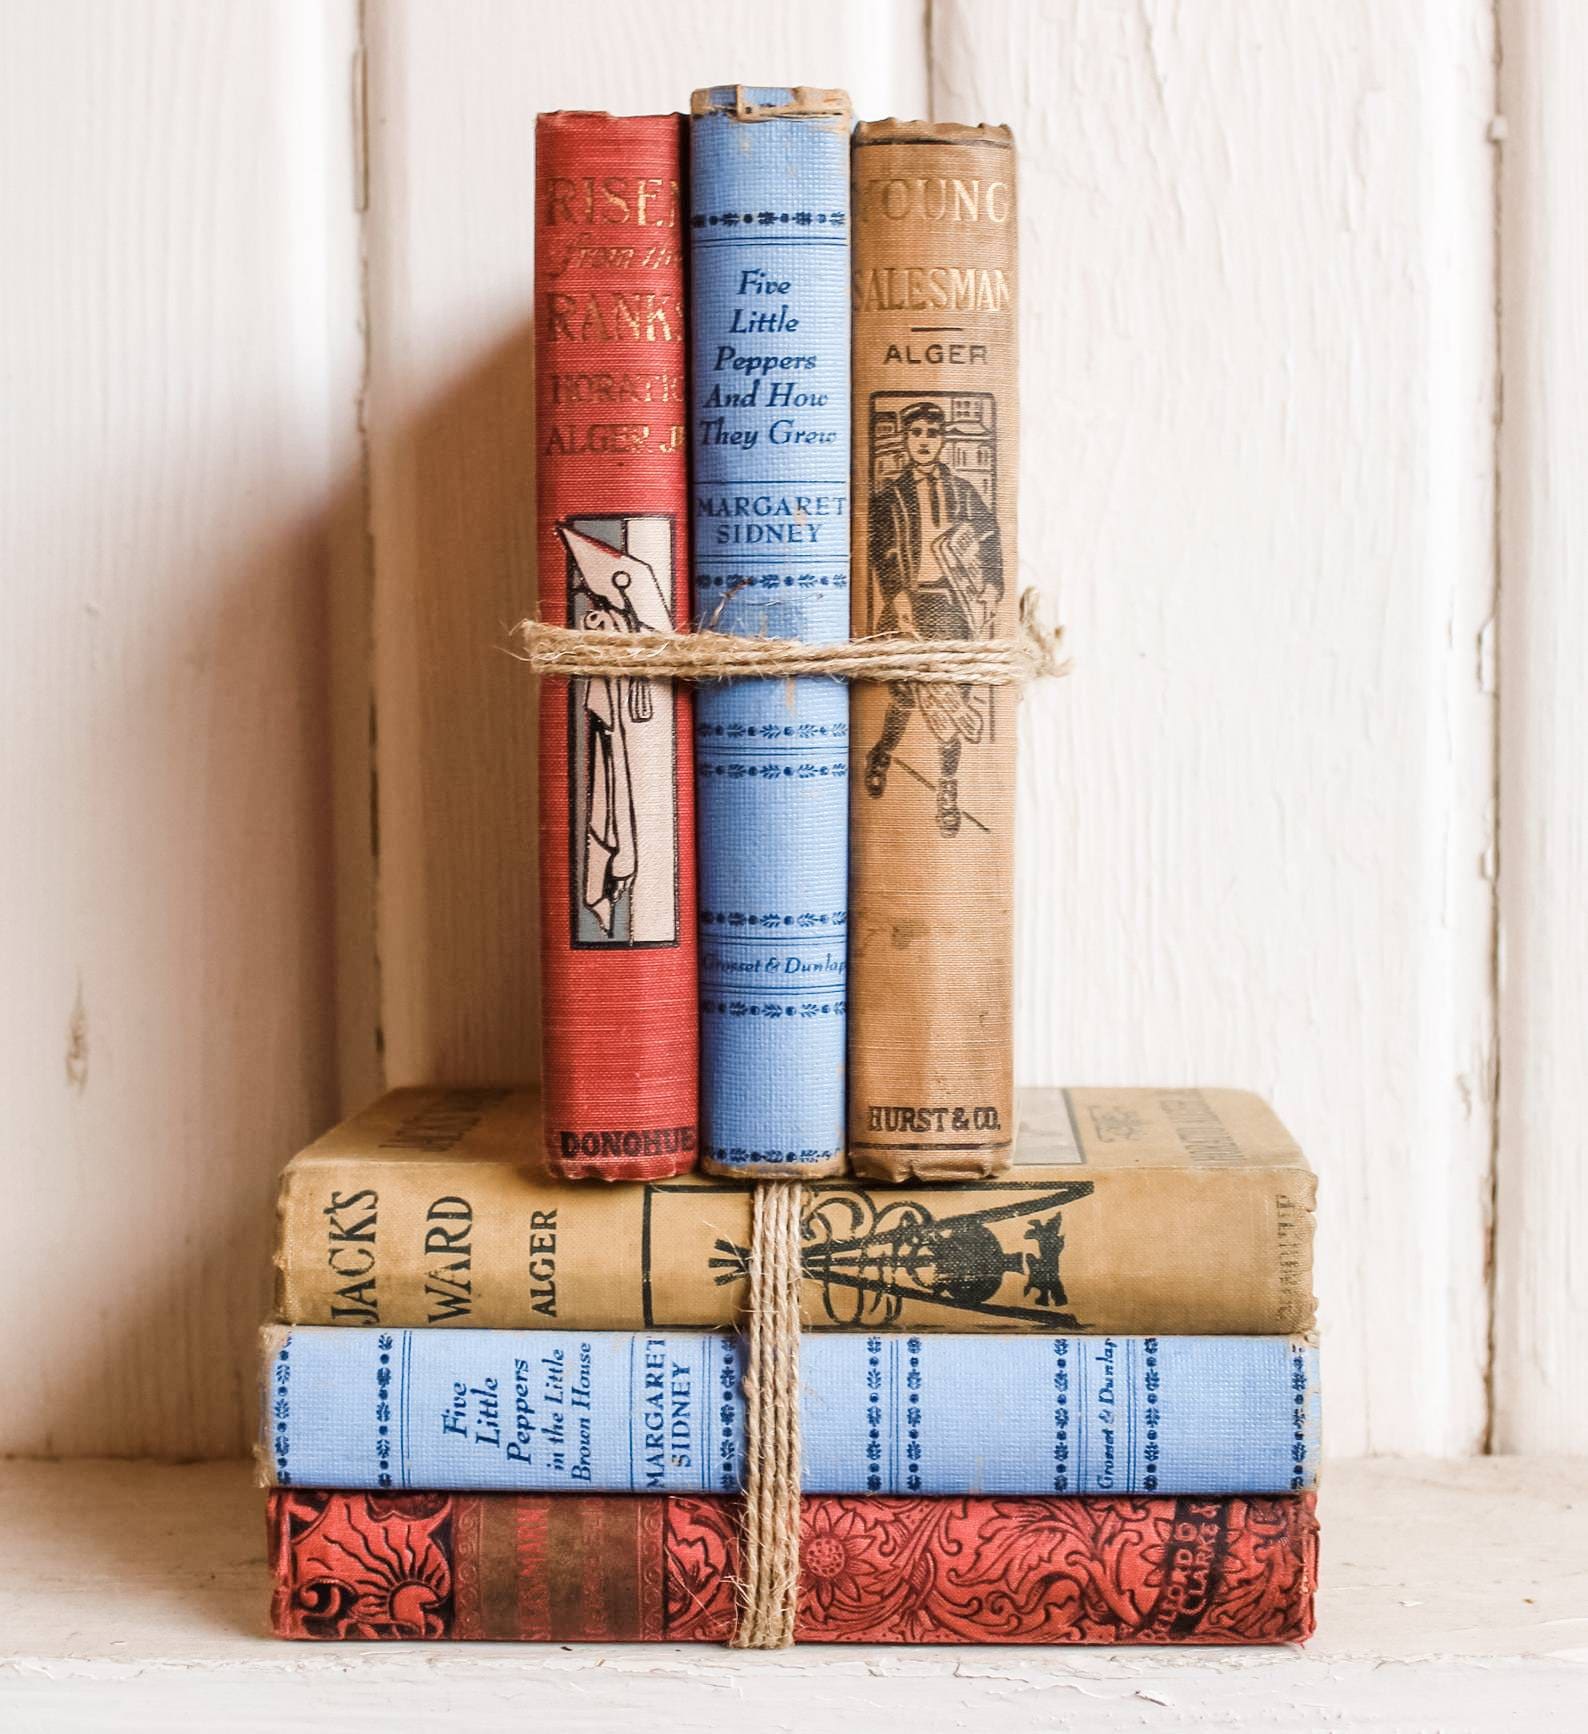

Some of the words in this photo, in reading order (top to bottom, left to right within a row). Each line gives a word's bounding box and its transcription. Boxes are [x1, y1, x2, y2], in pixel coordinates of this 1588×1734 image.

[642, 236, 682, 270] th
[737, 267, 792, 295] Five
[729, 304, 799, 333] Little
[713, 346, 817, 376] Peppers
[883, 343, 988, 366] ALGER
[702, 378, 761, 409] And
[765, 382, 829, 408] How
[700, 420, 760, 450] They
[769, 419, 838, 446] Grew
[697, 496, 847, 517] MARGARET
[716, 522, 824, 546] SIDNEY
[764, 956, 781, 973] &
[867, 1105, 949, 1132] HURST
[951, 1106, 970, 1131] &
[323, 1189, 380, 1325] JACK'S
[424, 1196, 473, 1324] WARD
[529, 1208, 559, 1318] ALGER
[541, 1348, 565, 1405] Little
[571, 1342, 592, 1411] House
[441, 1381, 468, 1438] Five
[470, 1377, 501, 1449] Little
[506, 1358, 537, 1466] Peppers
[644, 1336, 667, 1489] MARGARET
[670, 1361, 692, 1468] SIDNEY
[541, 1412, 565, 1444] the
[545, 1452, 565, 1471] in
[571, 1417, 592, 1483] Brown
